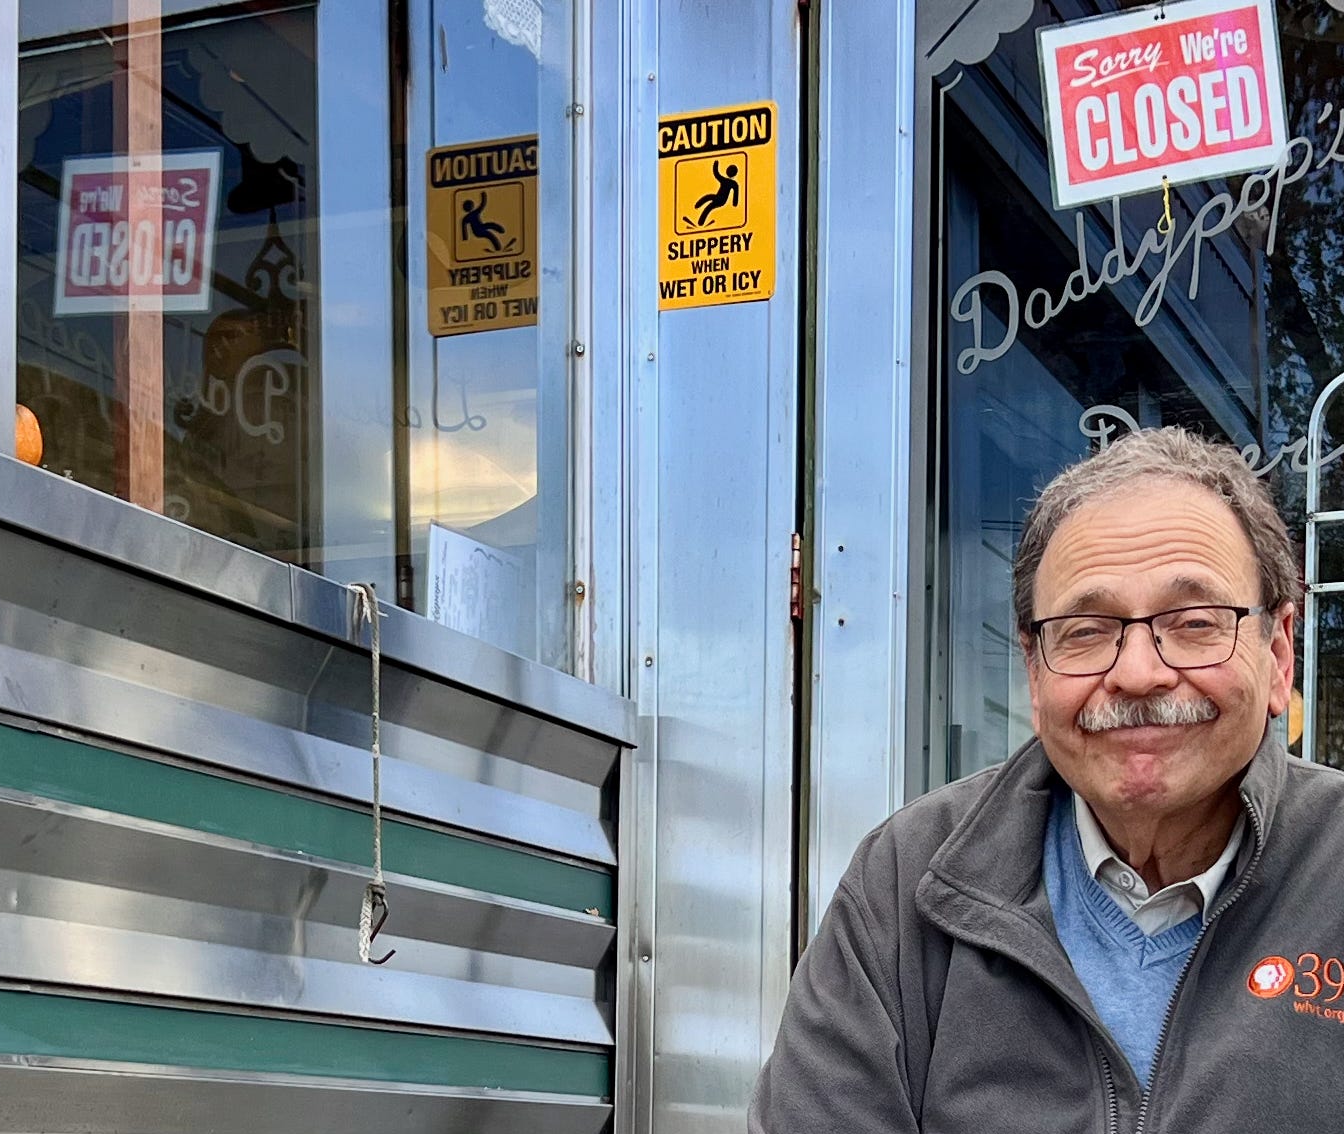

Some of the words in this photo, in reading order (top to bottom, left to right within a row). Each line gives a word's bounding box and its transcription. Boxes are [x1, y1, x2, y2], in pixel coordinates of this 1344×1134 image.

[1069, 41, 1163, 88] Sorry
[1179, 27, 1248, 65] We're
[659, 114, 767, 152] CAUTION
[1074, 65, 1263, 172] CLOSED
[667, 232, 753, 260] SLIPPERY
[691, 257, 730, 274] WHEN
[660, 278, 697, 299] WET
[702, 274, 727, 294] OR
[732, 270, 762, 291] ICY
